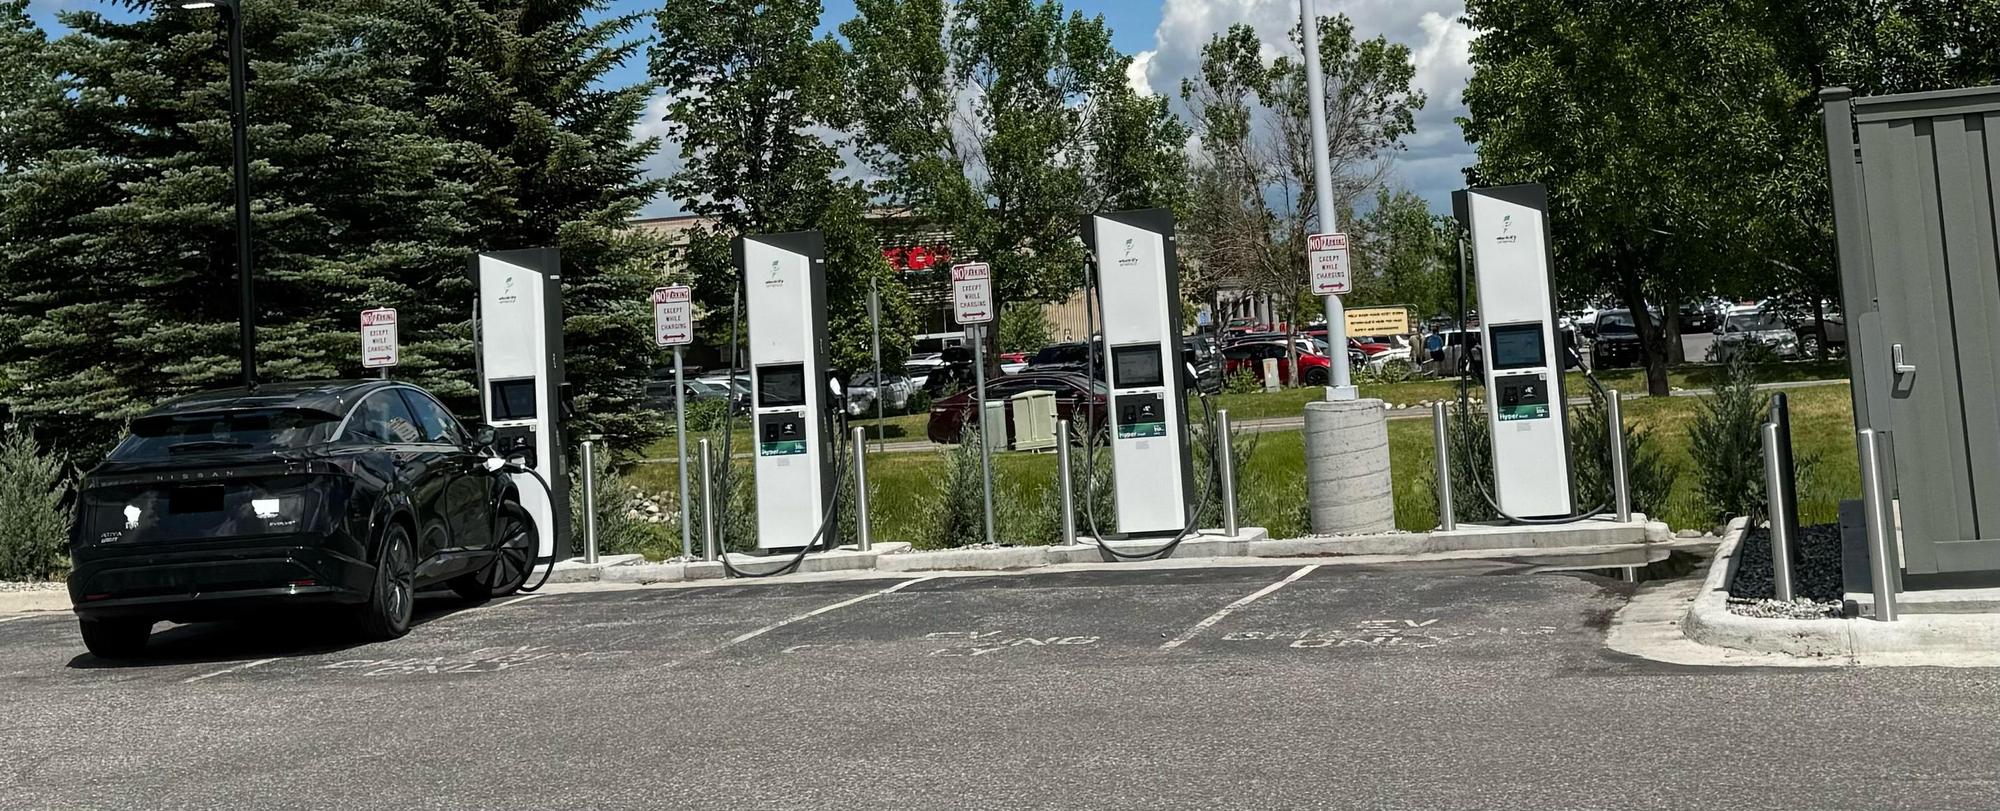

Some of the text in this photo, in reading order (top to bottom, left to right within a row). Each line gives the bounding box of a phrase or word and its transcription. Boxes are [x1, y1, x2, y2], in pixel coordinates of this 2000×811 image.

[1310, 237, 1345, 251] NO PARKING
[954, 267, 987, 280] NO PARKING
[1316, 271, 1345, 279] CHARGING
[655, 290, 688, 303] NO PARKING
[960, 300, 986, 308] CHARGING
[661, 322, 686, 330] CHARGING
[156, 471, 234, 480] NISSAN
